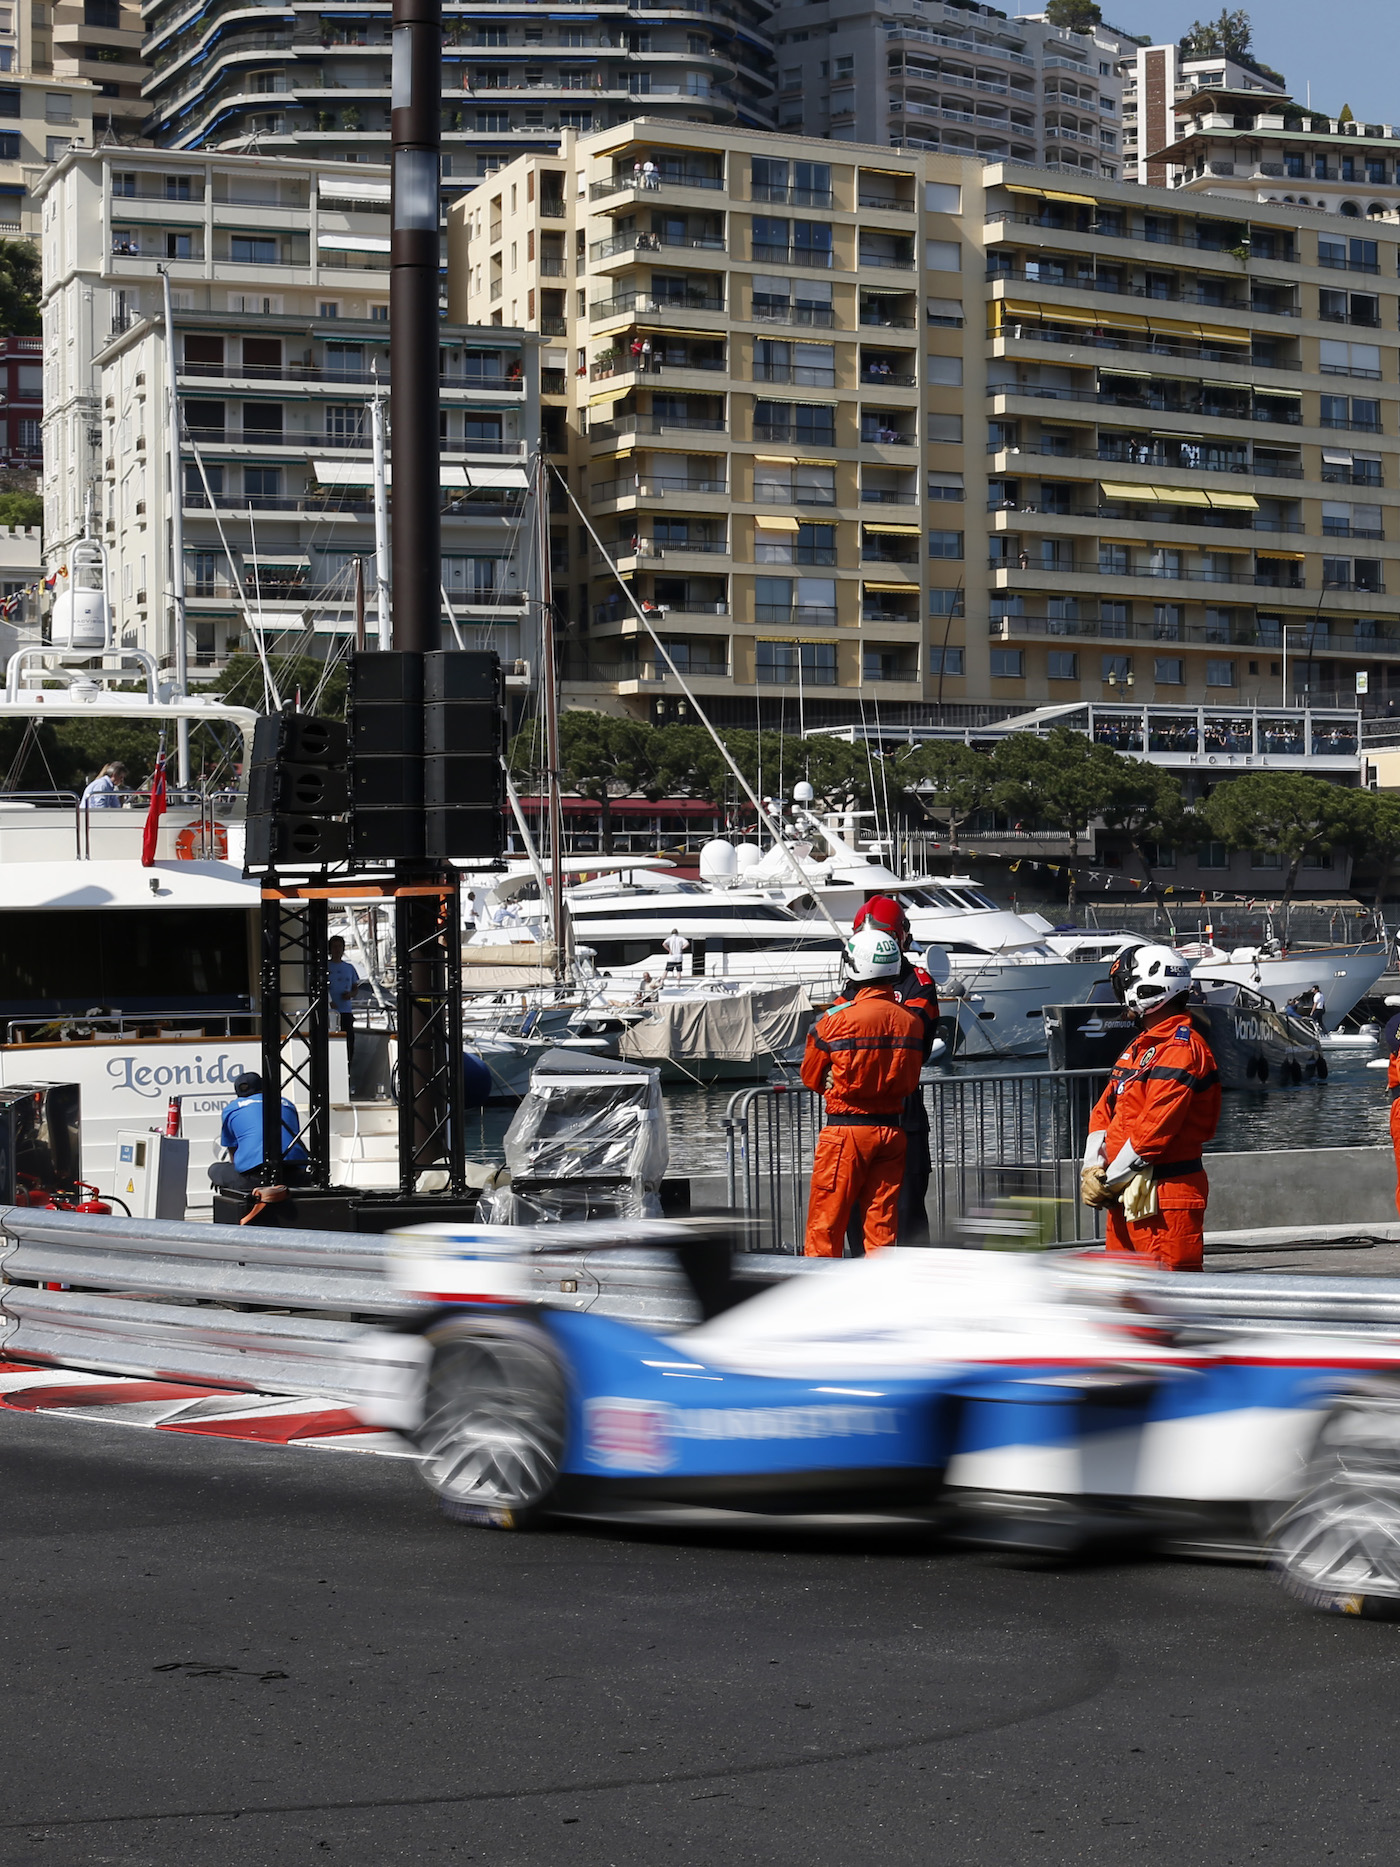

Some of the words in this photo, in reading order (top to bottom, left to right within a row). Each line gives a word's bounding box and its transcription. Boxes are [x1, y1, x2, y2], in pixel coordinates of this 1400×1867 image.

[1189, 755, 1268, 765] HOTEL
[876, 940, 897, 952] 409
[1234, 1015, 1273, 1040] VanDutch
[107, 1054, 245, 1098] Leonida
[1117, 1081, 1125, 1095] 6
[194, 1100, 233, 1112] LOND
